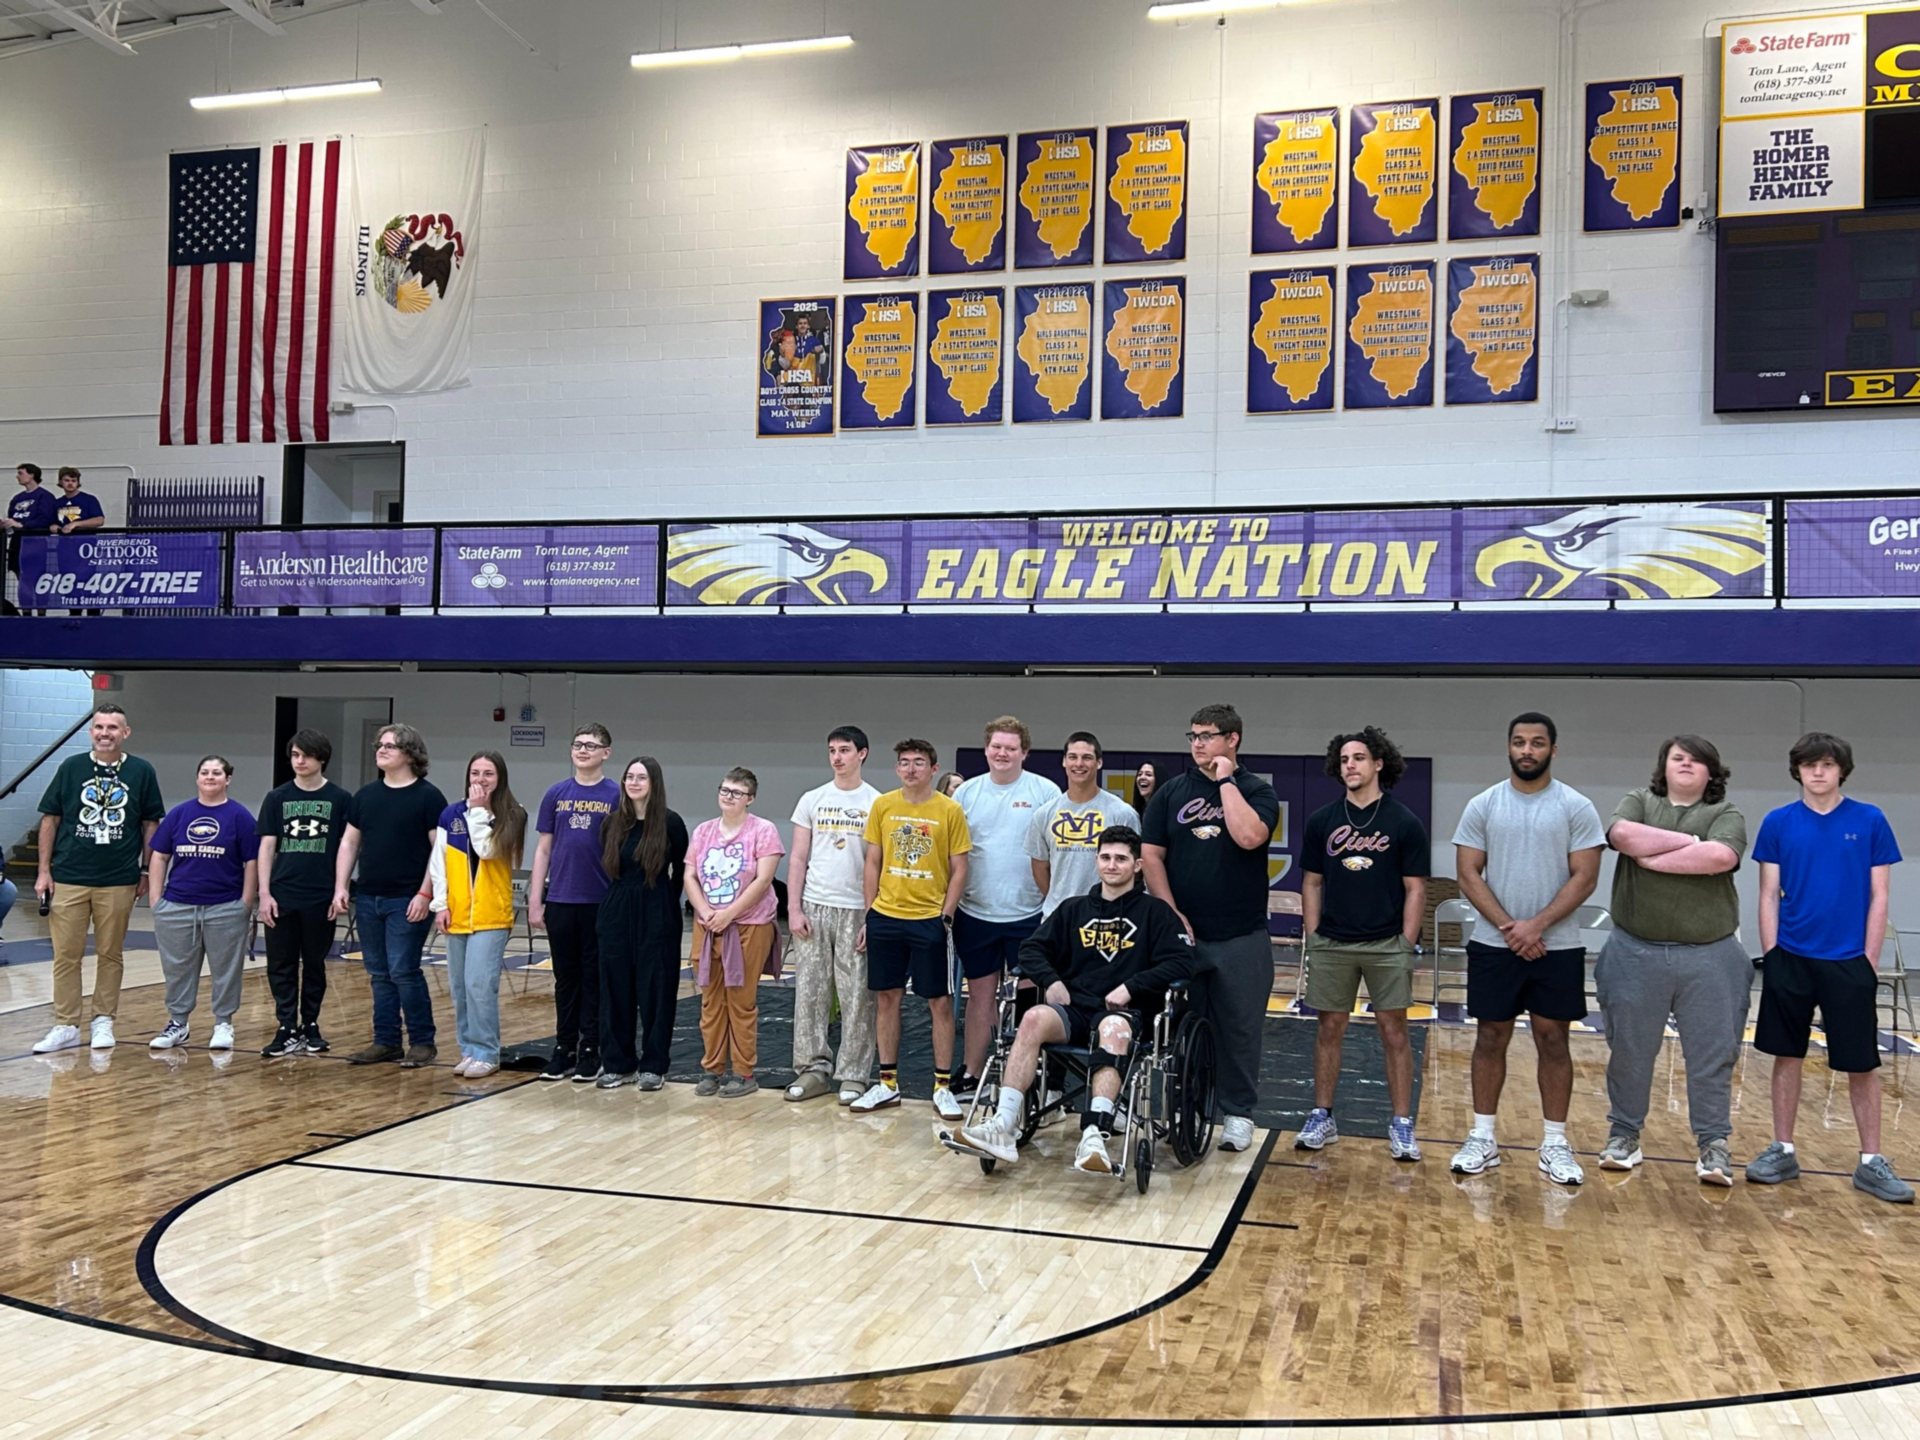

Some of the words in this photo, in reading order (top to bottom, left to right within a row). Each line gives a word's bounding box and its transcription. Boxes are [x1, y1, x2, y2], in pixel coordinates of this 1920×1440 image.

[1749, 66, 1773, 76] Tom
[1777, 64, 1809, 74] Lane,
[1813, 61, 1846, 71] Agent
[1754, 79, 1781, 91] (618)
[1784, 75, 1832, 87] 377-8912
[1631, 84, 1655, 94] 2013
[1494, 96, 1516, 106] 2012
[1740, 88, 1846, 104] tomlaneagency.net
[1392, 104, 1413, 115] 2011
[1622, 97, 1660, 112] IHSA
[1488, 108, 1523, 123] IHSA
[1386, 117, 1420, 131] IHSA
[1595, 124, 1648, 134] COMPETITIVE
[1652, 122, 1677, 131] DANCE
[1145, 126, 1165, 137] 1985
[1288, 126, 1323, 140] IHSA
[1483, 135, 1519, 145] WRESTLING
[1618, 138, 1639, 146] CLASS
[1770, 129, 1813, 146] THE
[1140, 139, 1171, 152] IHSA
[1049, 146, 1080, 159] IHSA
[1284, 151, 1317, 160] WRESTLING
[1386, 148, 1421, 156] SOFTBALL
[1480, 150, 1499, 158] STATE
[1502, 147, 1535, 156] CHAMPION
[1609, 151, 1633, 159] STATE
[1636, 149, 1661, 158] FINALS
[1753, 145, 1829, 165] HOMER
[961, 153, 991, 166] IHSA
[1385, 161, 1406, 169] CLASS
[877, 160, 906, 173] IHSA
[1135, 164, 1167, 172] WRESTLING
[1302, 163, 1332, 172] CHAMPION
[1633, 163, 1653, 171] PLACE
[1045, 171, 1076, 179] WRESTLING
[1378, 174, 1400, 182] STATE
[1404, 172, 1428, 180] FINALS
[1754, 163, 1829, 183] HENKE
[957, 177, 987, 185] WRESTLING
[873, 185, 903, 193] WRESTLING
[1400, 185, 1421, 193] PLACE
[1750, 180, 1833, 201] FAMILY
[356, 225, 370, 296] ILLINOIS
[1491, 259, 1514, 270] 2021
[1389, 265, 1411, 276] 2021
[1290, 272, 1312, 283] 2021
[1481, 274, 1529, 287] IWCOA
[1142, 282, 1163, 291] 2021
[1380, 280, 1426, 293] IWCOA
[962, 292, 984, 302] 2023
[1281, 286, 1323, 299] IWCOA
[878, 297, 899, 307] 2024
[1047, 300, 1077, 313] IHSA
[1133, 295, 1176, 307] IWCOA
[793, 303, 817, 312] 2025
[957, 305, 987, 317] IHSA
[1479, 304, 1523, 313] WRESTLING
[872, 310, 901, 322] IHSA
[1280, 315, 1320, 324] WRESTLING
[1377, 310, 1420, 319] WRESTLING
[949, 329, 986, 337] WRESTLING
[1054, 329, 1087, 337] BASKETBALL
[1132, 324, 1171, 332] WRESTLING
[864, 334, 900, 342] WRESTLING
[1490, 330, 1508, 338] STATE
[1502, 342, 1525, 350] PLACE
[781, 370, 812, 383] IHSA
[761, 387, 777, 395] BOYS
[792, 409, 820, 417] WEBER
[1061, 519, 1216, 548] WELCOME
[1229, 517, 1270, 543] TO
[79, 543, 158, 559] OUTDOOR
[535, 545, 558, 556] Tom
[562, 545, 591, 556] Lane,
[595, 545, 629, 556] Agent
[256, 552, 326, 575] Anderson
[330, 551, 428, 575] Healthcare
[546, 562, 570, 572] (618)
[572, 562, 615, 571] 377-8912
[917, 548, 1132, 600] EAGLE
[1148, 541, 1438, 599] NATION
[35, 571, 202, 595] 618-407-TREE
[241, 578, 256, 587] Get
[259, 578, 267, 586] to
[269, 577, 294, 586] know
[297, 578, 306, 586] us
[309, 579, 315, 587] @
[523, 577, 640, 586] www.tomlaneagency.net
[61, 596, 77, 605] Tree
[80, 596, 107, 605] Service
[117, 596, 139, 605] Stump
[142, 596, 175, 604] Removal
[283, 800, 332, 820] UNDER
[280, 837, 327, 853] ARMOUR
[1327, 825, 1390, 856] Civic
